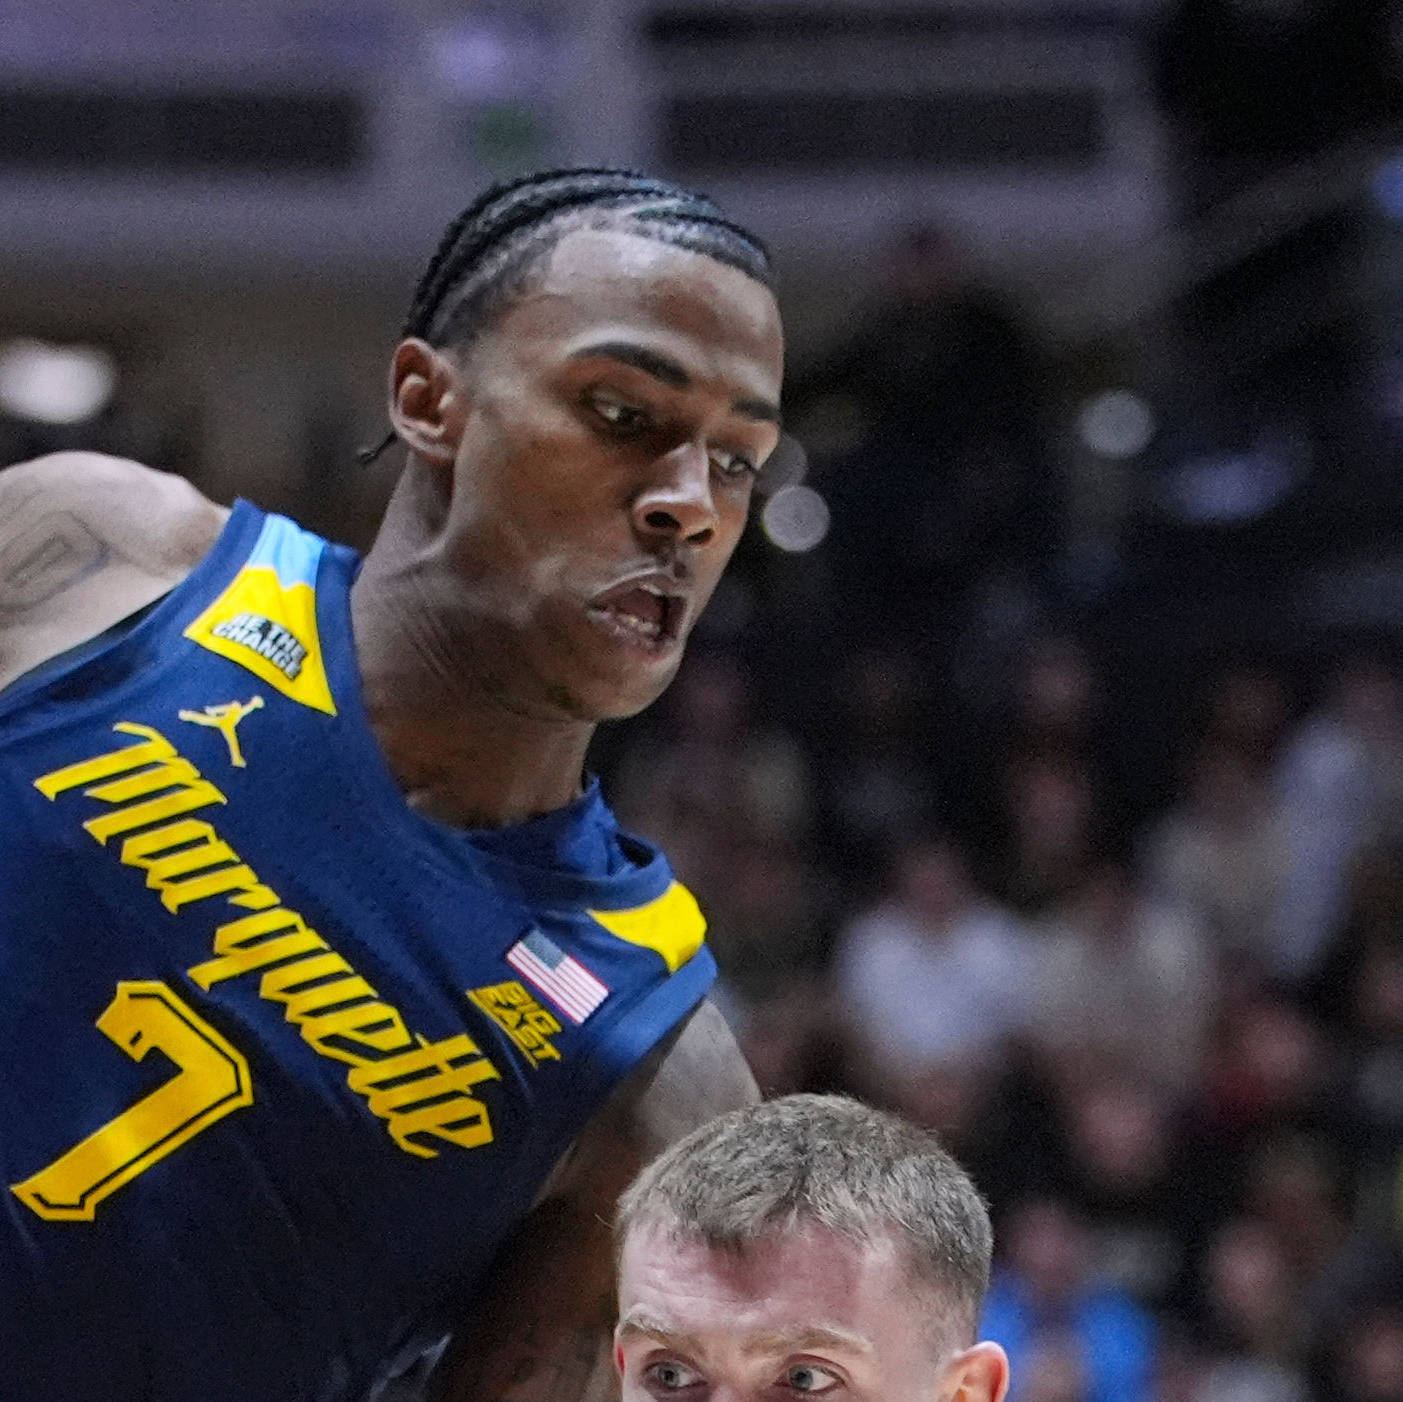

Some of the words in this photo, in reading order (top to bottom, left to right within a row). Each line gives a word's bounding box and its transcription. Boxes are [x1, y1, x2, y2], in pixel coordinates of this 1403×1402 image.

[34, 722, 501, 1158] Marquette
[492, 980, 563, 1036] BIG
[11, 980, 255, 1222] 7
[474, 986, 563, 1062] EAST
